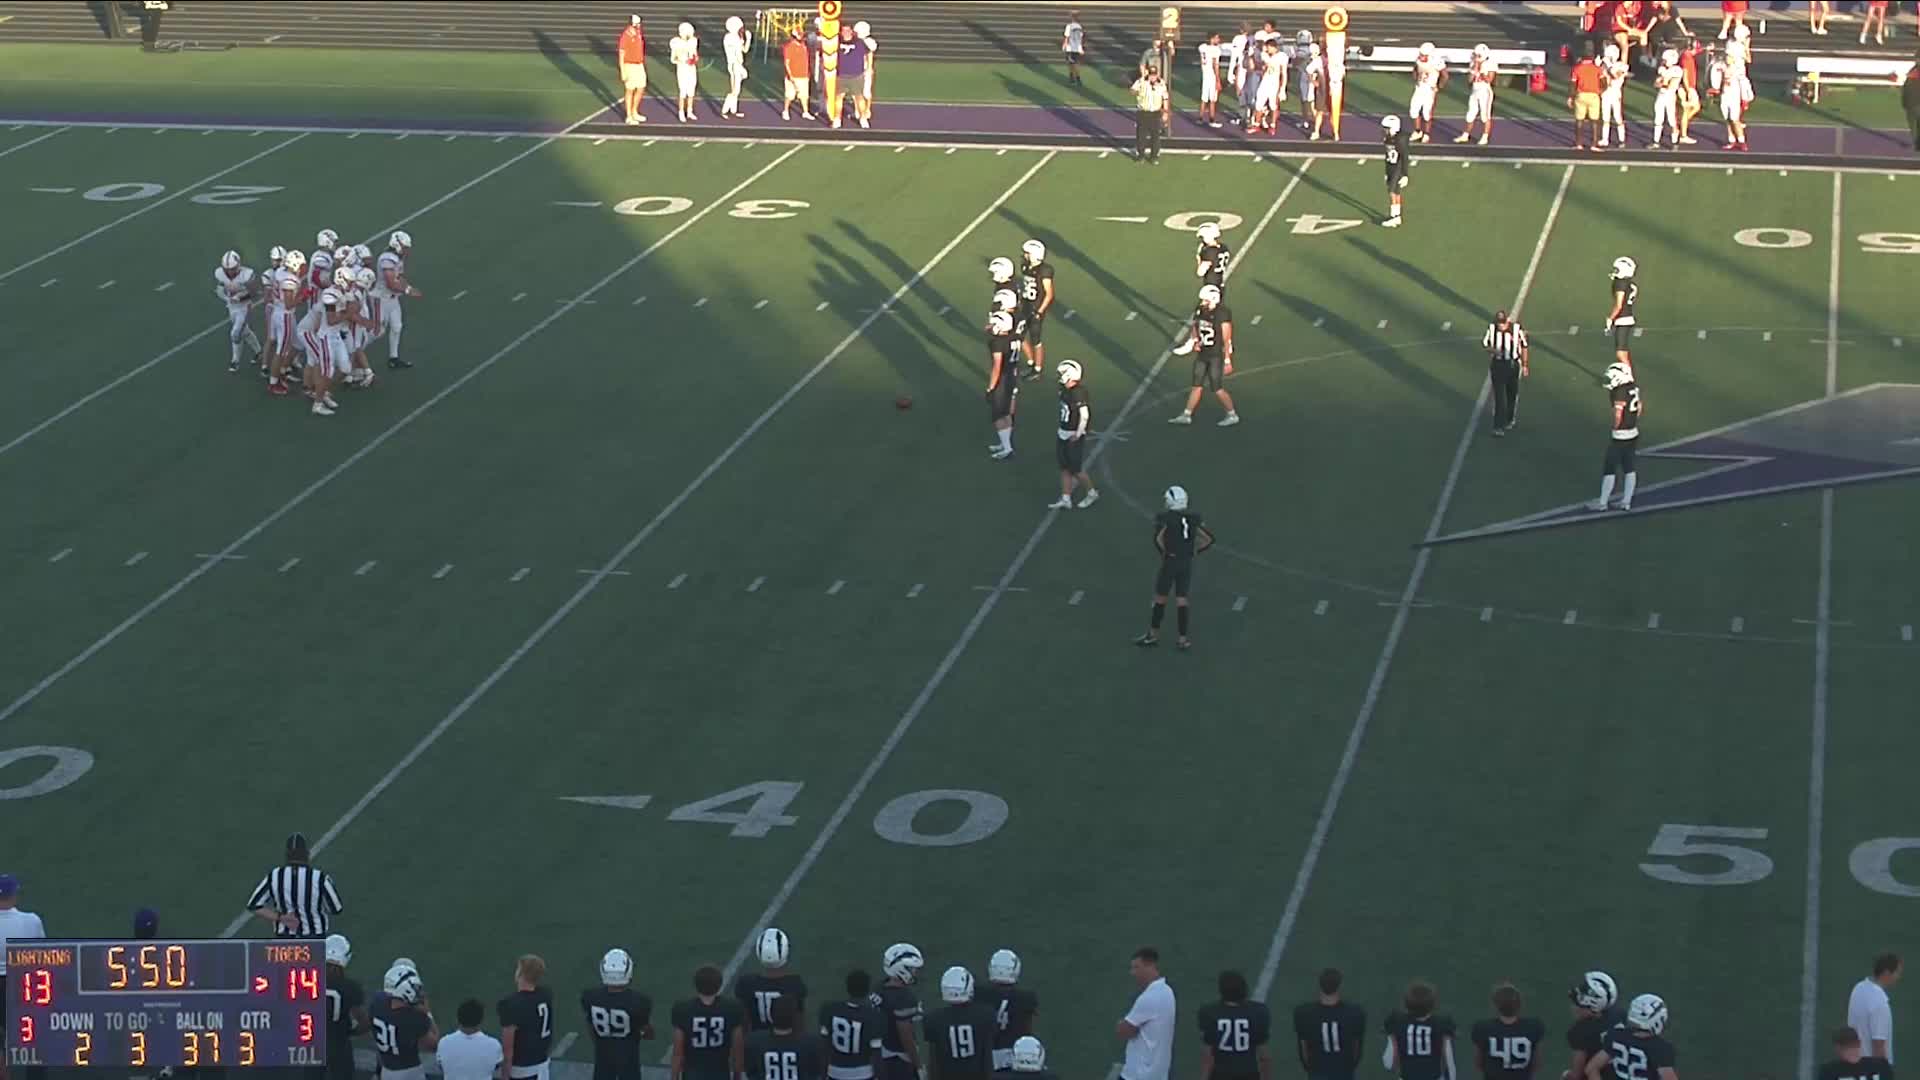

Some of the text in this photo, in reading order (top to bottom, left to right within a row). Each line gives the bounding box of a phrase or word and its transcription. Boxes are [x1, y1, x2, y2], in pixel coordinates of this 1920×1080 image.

[1162, 7, 1179, 28] 2
[1181, 516, 1189, 539] 1
[373, 1017, 399, 1055] 31
[591, 1005, 631, 1038] 89
[692, 1017, 725, 1048] 53
[831, 1016, 863, 1053] 81
[1217, 1018, 1250, 1052] 26
[1321, 1021, 1341, 1052] 11
[949, 1025, 976, 1058] 19
[1406, 1024, 1432, 1056] 10
[1488, 1037, 1531, 1069] 49
[764, 1051, 799, 1080] 66
[1611, 1042, 1648, 1080] 22
